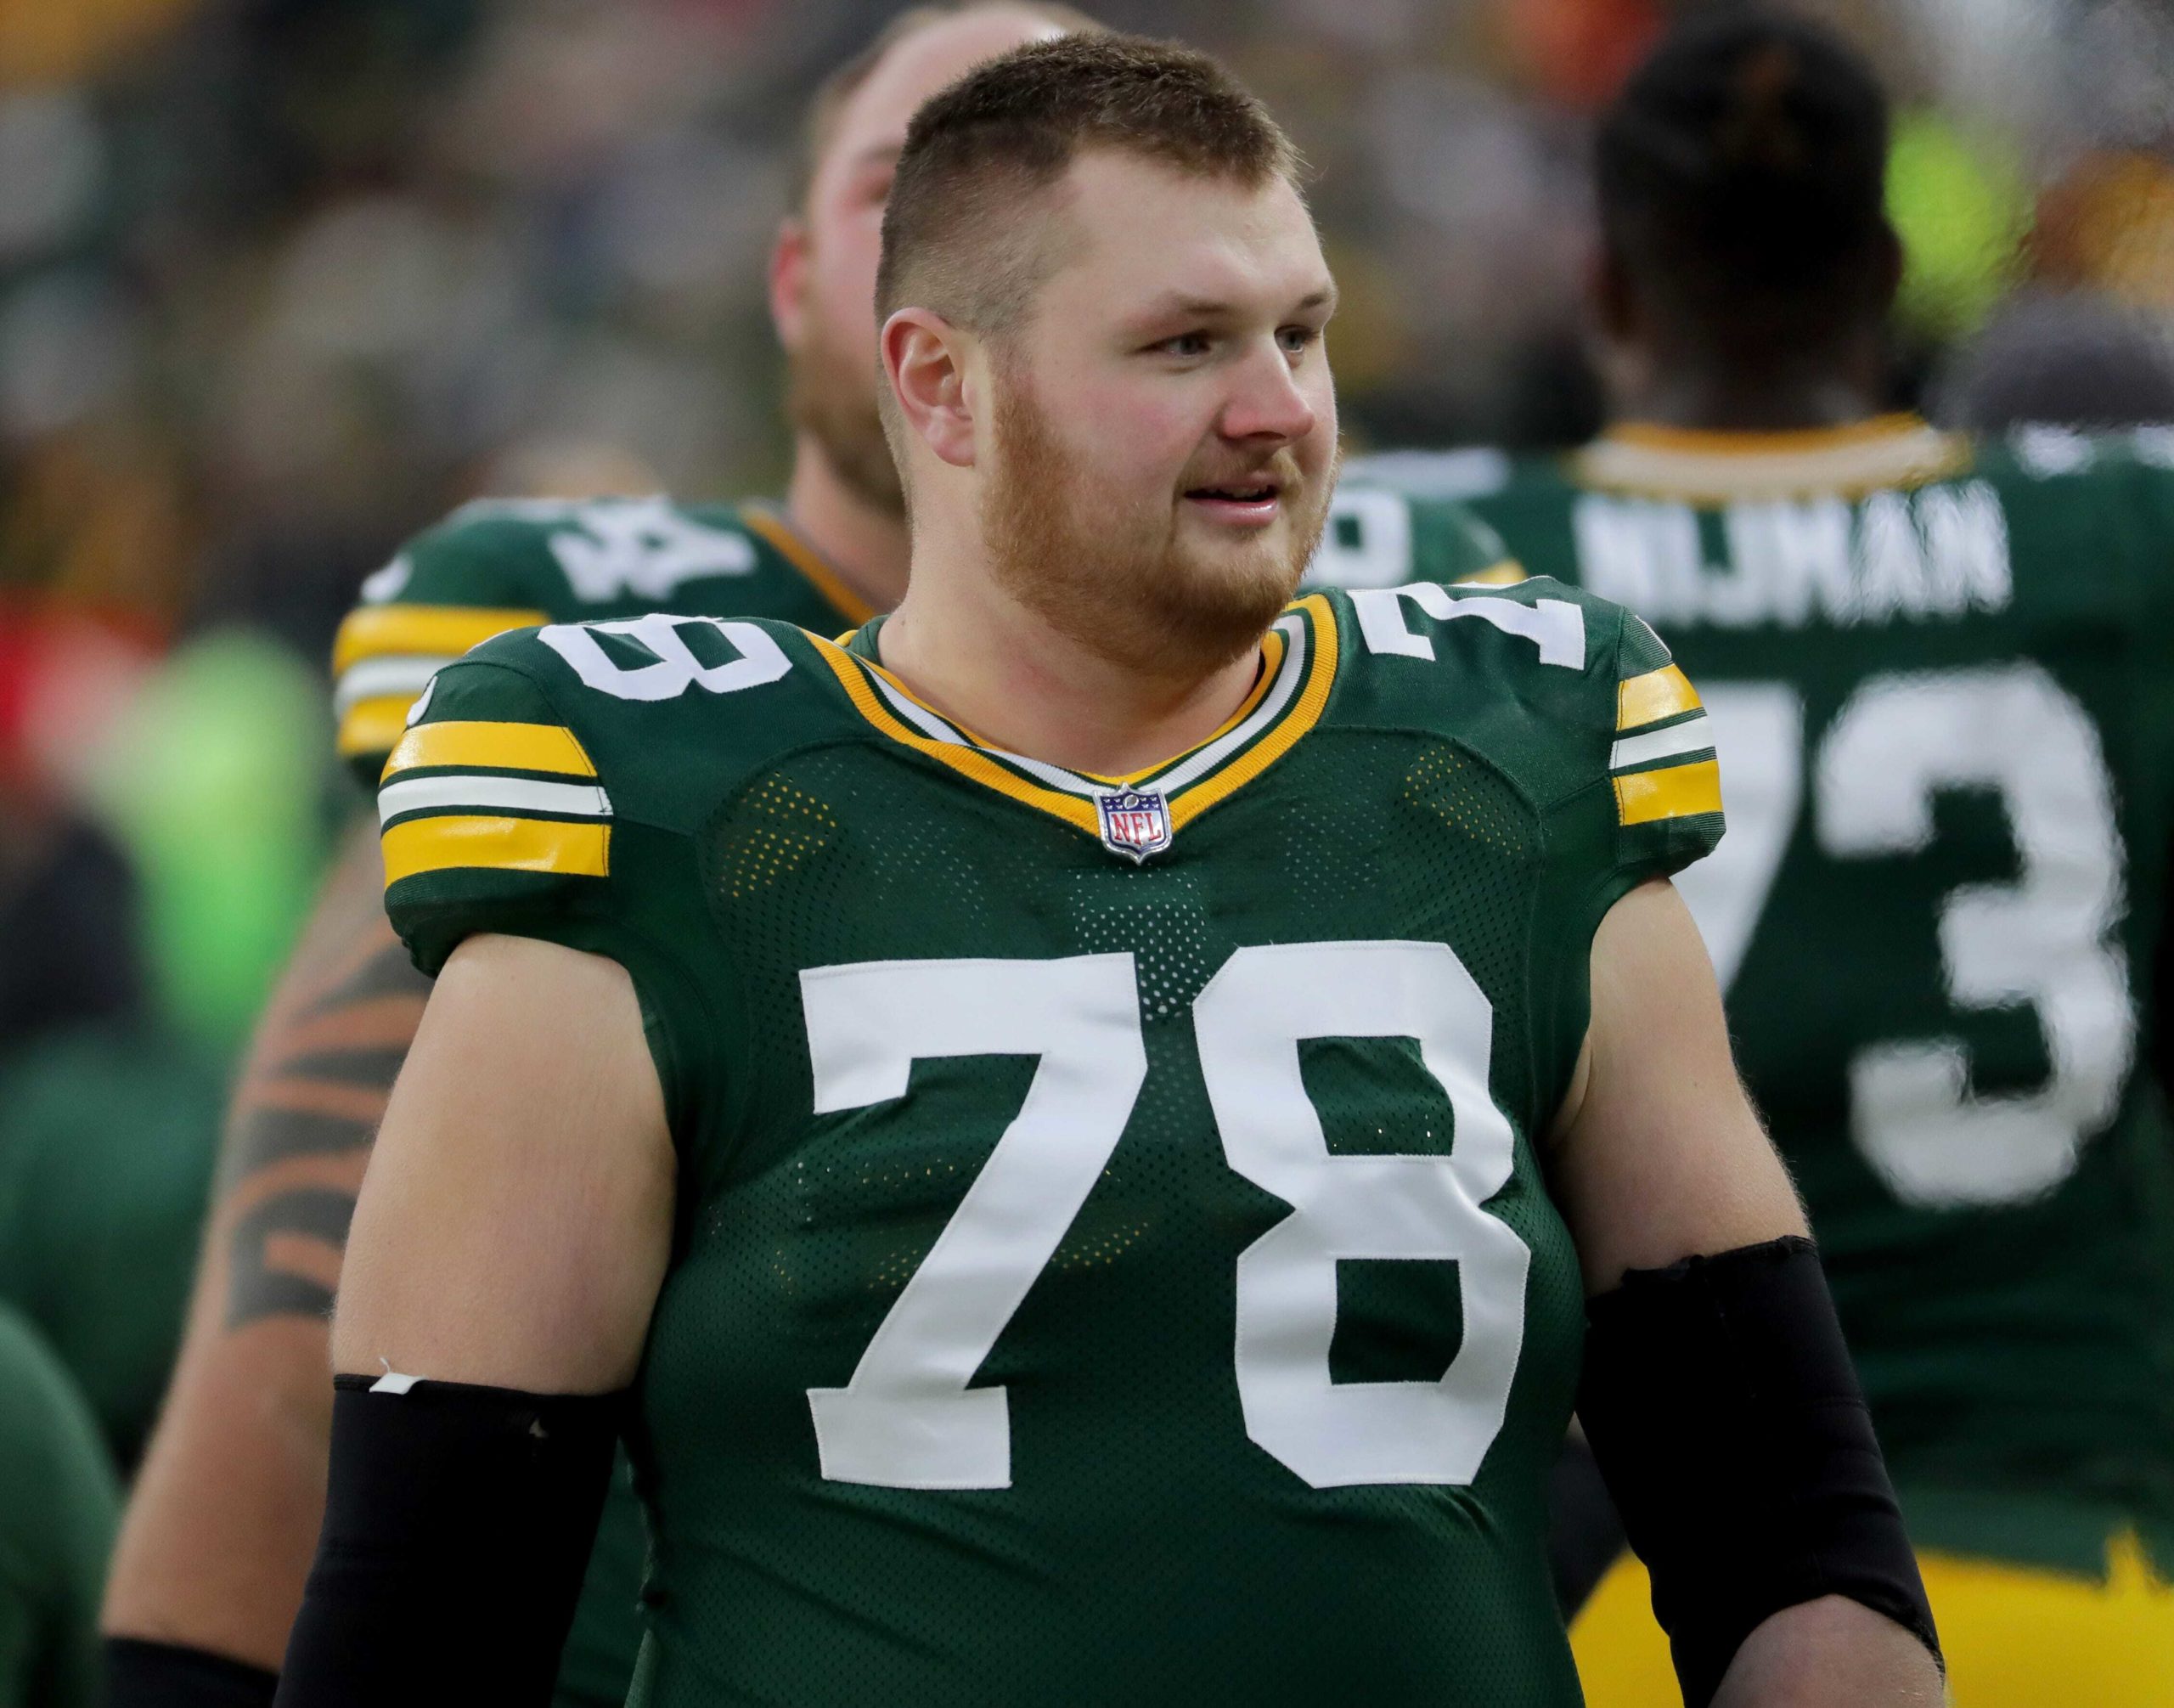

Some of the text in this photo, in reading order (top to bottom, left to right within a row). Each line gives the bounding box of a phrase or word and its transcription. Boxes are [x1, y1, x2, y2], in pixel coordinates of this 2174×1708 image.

[1571, 482, 2014, 629] NIJMAN
[1111, 812, 1162, 846] NFL
[798, 939, 1532, 1490] 78
